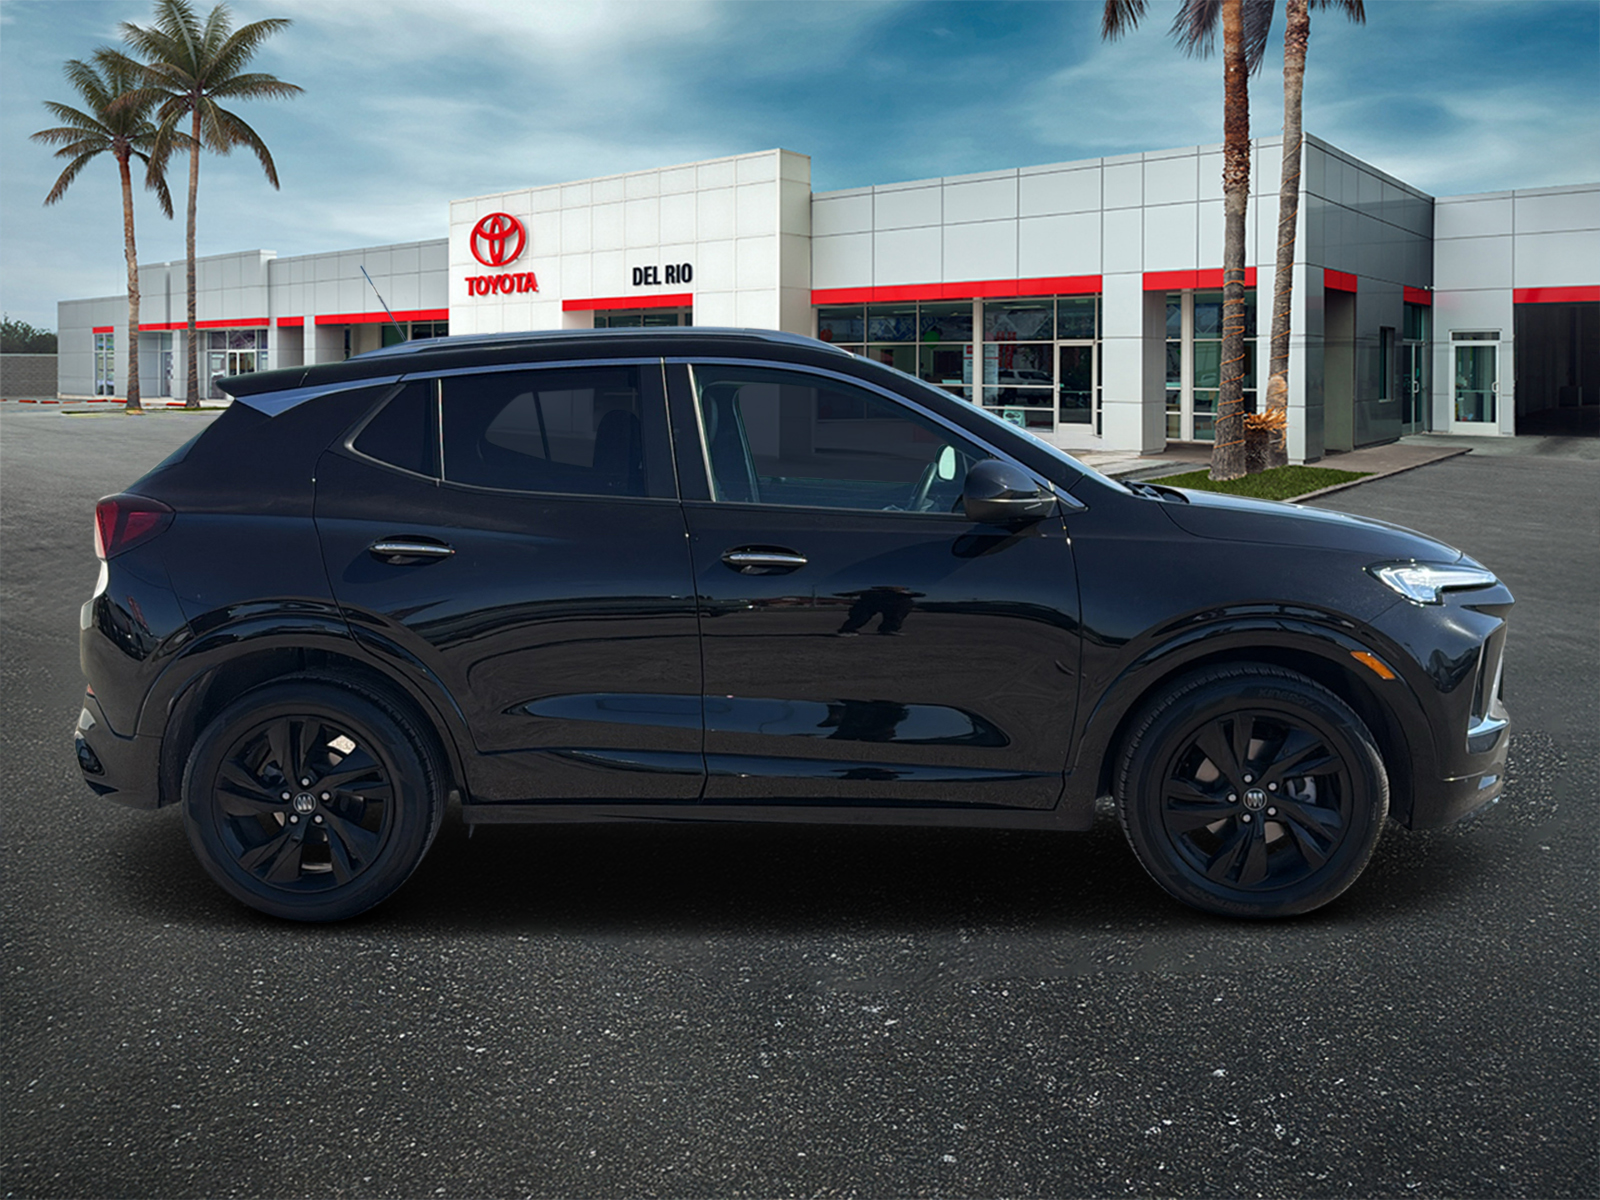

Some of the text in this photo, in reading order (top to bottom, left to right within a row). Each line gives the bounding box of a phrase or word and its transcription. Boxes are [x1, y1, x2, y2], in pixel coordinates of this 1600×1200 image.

[465, 272, 538, 296] TOYOTA
[632, 263, 693, 286] DEL RIO
